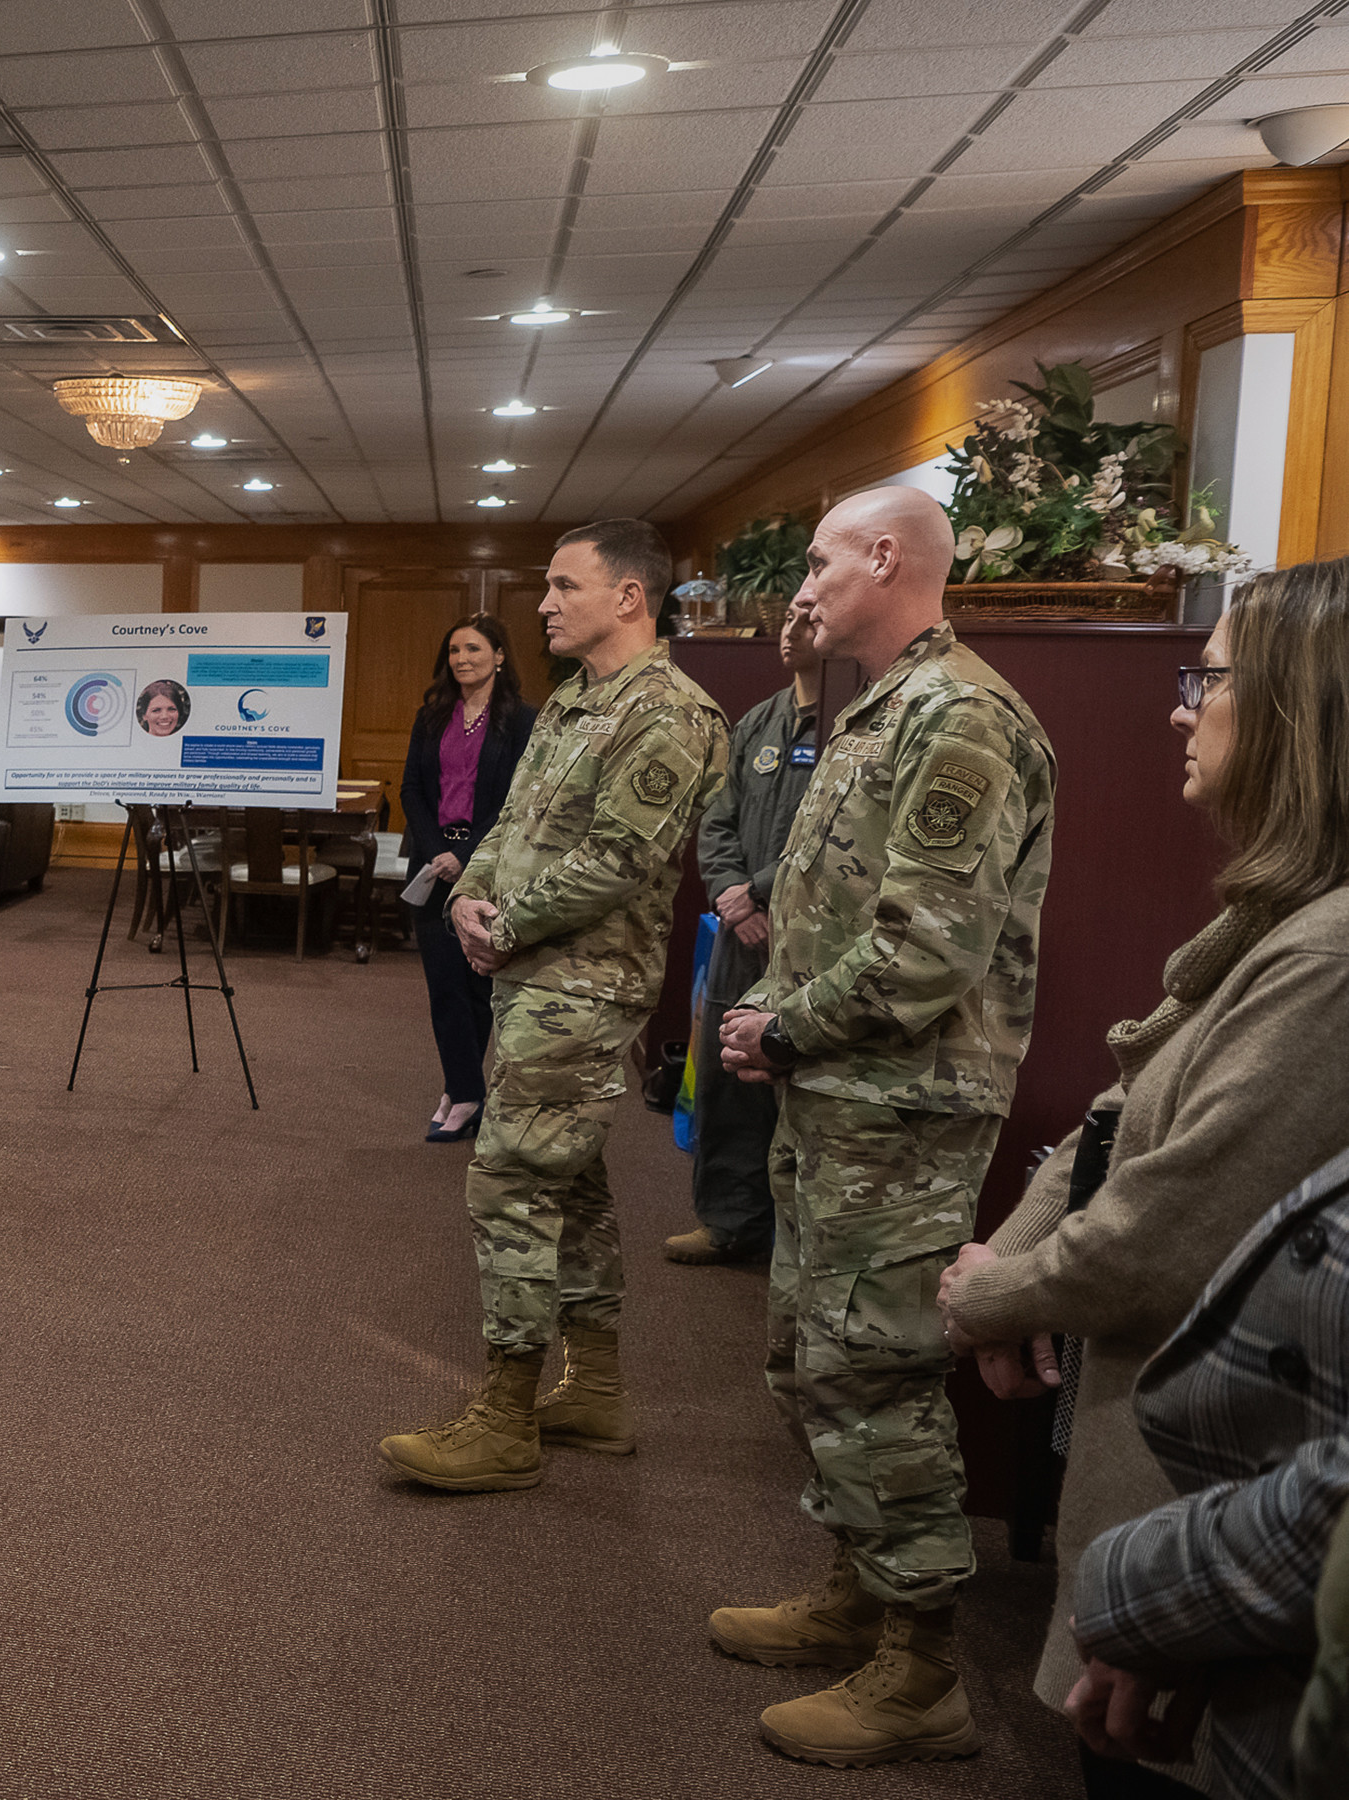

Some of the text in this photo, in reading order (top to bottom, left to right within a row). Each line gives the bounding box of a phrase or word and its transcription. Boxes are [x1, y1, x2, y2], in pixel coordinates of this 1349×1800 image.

[111, 623, 208, 637] Courtney's Cove
[214, 724, 290, 733] COURTNEY'S COVE
[128, 772, 151, 780] military
[945, 764, 984, 787] RAVEN
[939, 780, 975, 801] RANGER
